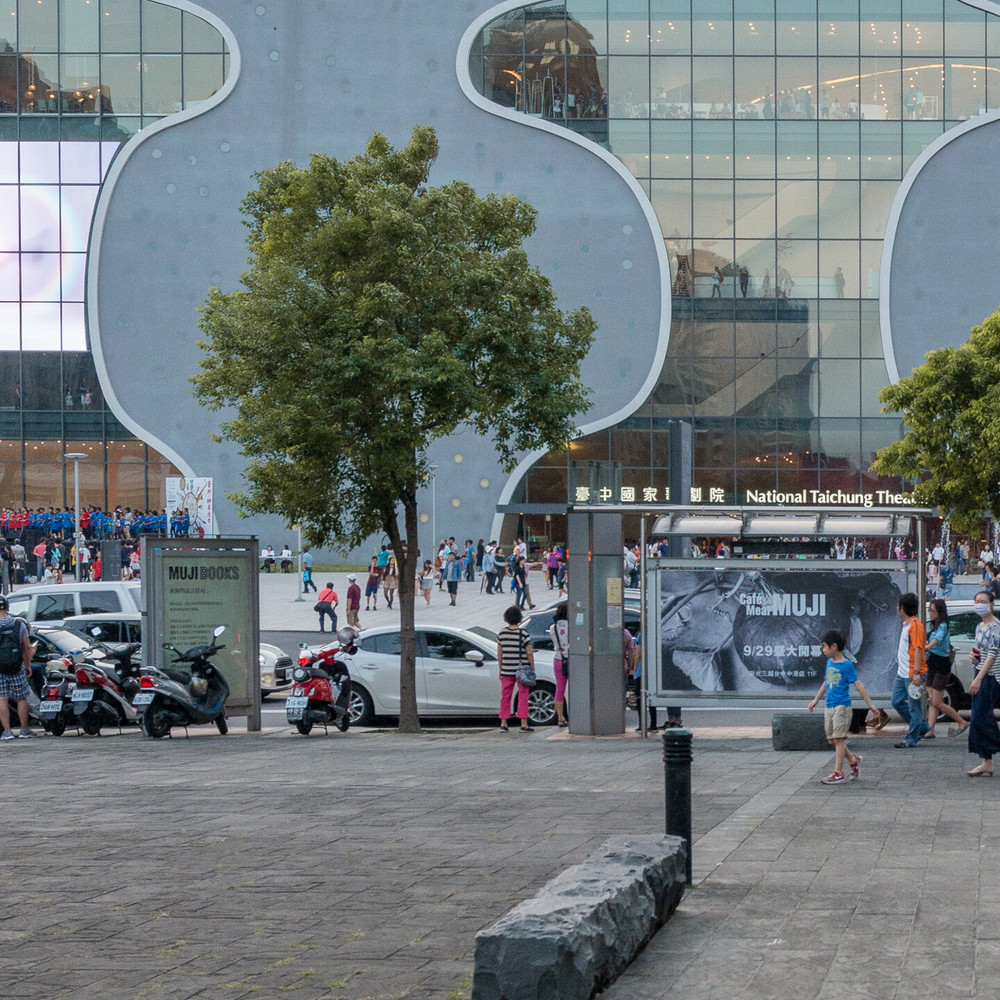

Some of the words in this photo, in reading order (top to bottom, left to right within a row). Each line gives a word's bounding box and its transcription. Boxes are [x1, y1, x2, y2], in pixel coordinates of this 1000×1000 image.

[746, 489, 807, 504] National
[809, 489, 873, 508] Taichung
[169, 566, 198, 580] MUJI
[200, 566, 240, 580] BOOKS
[772, 593, 826, 616] MUJI
